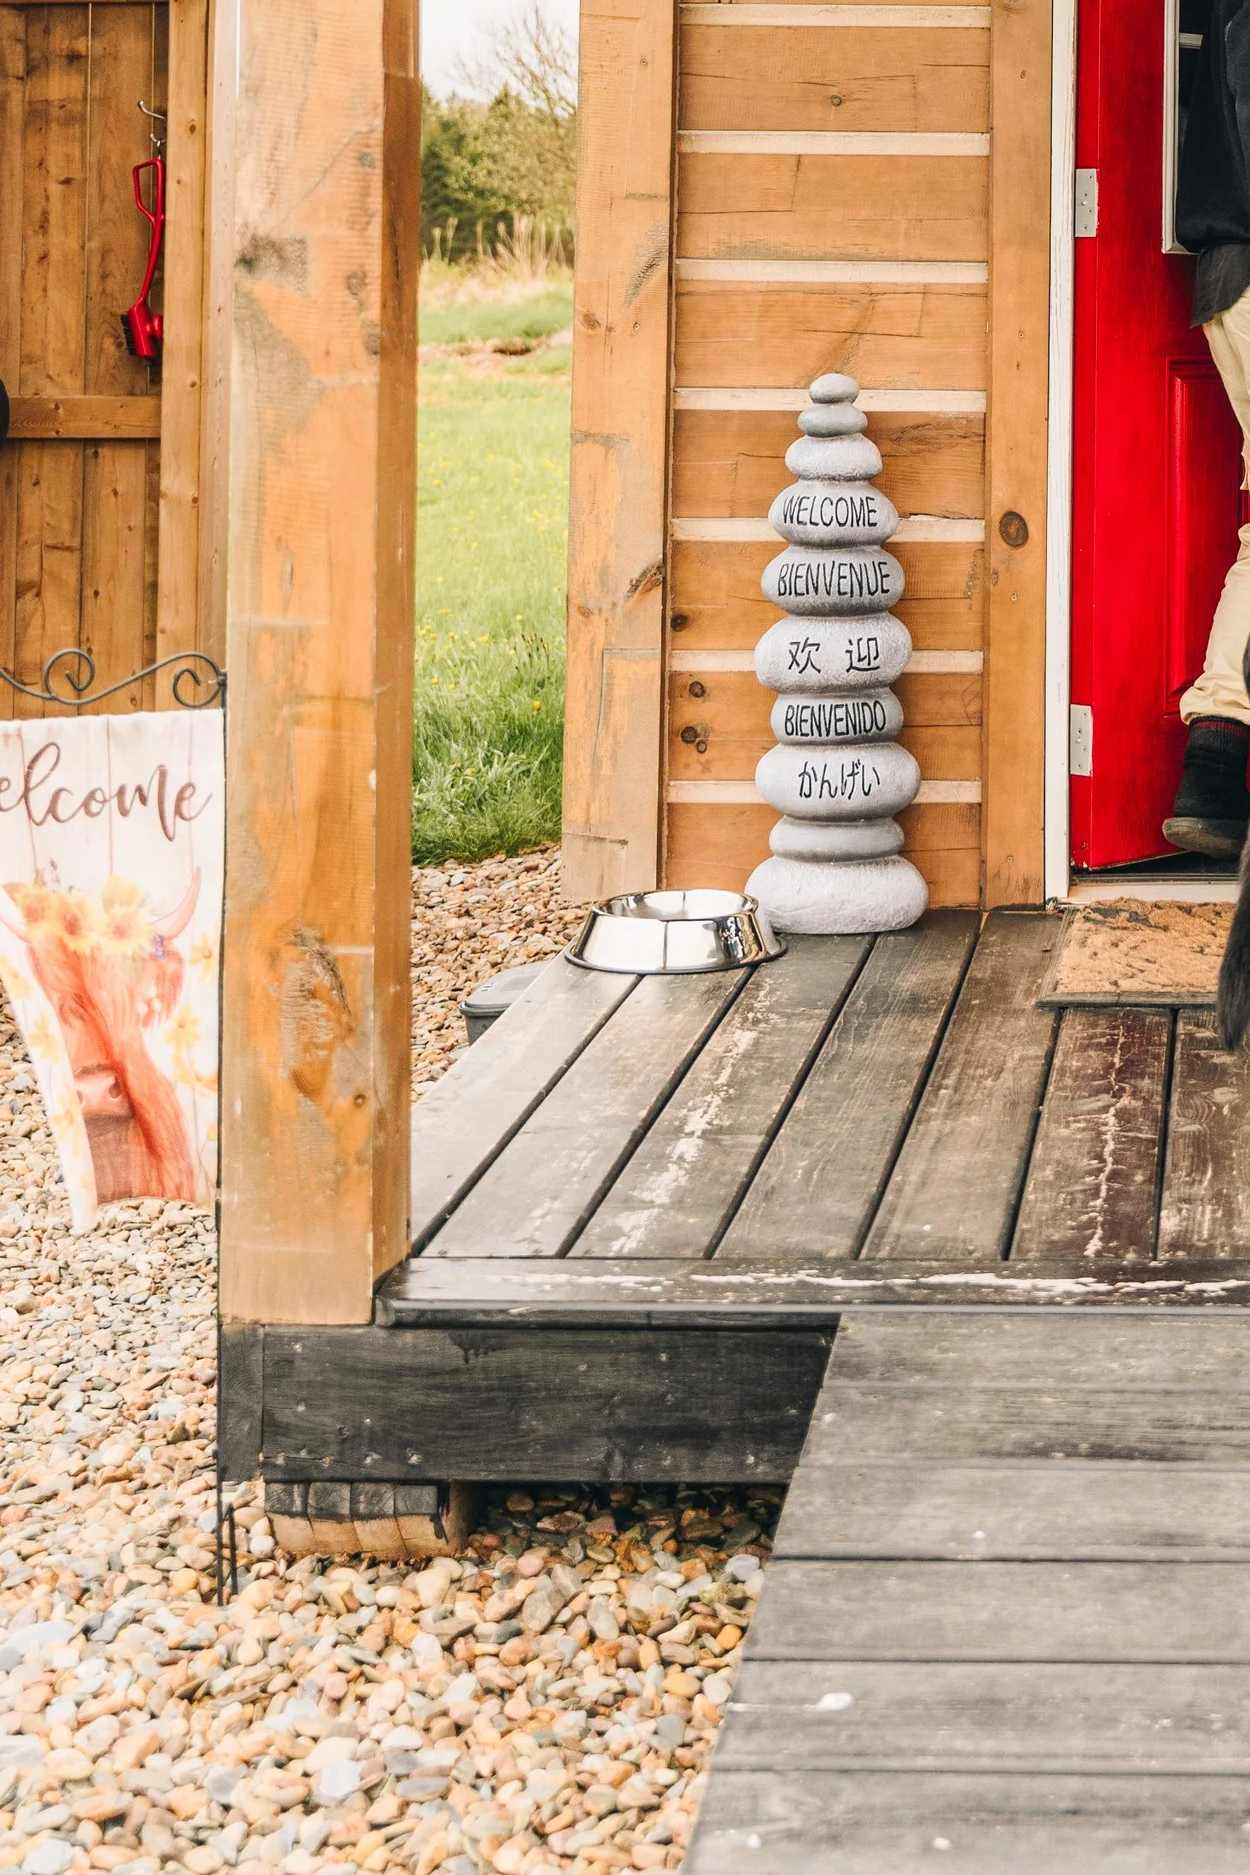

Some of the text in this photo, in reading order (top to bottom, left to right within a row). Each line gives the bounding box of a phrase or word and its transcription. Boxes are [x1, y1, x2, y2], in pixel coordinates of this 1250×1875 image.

[782, 495, 878, 528] WELCOME
[777, 559, 890, 598] BIENVENUE
[787, 636, 881, 674] 欢迎
[784, 699, 887, 738] BIENVENIDO
[0, 742, 213, 842] elcome
[798, 758, 881, 800] かんげい
